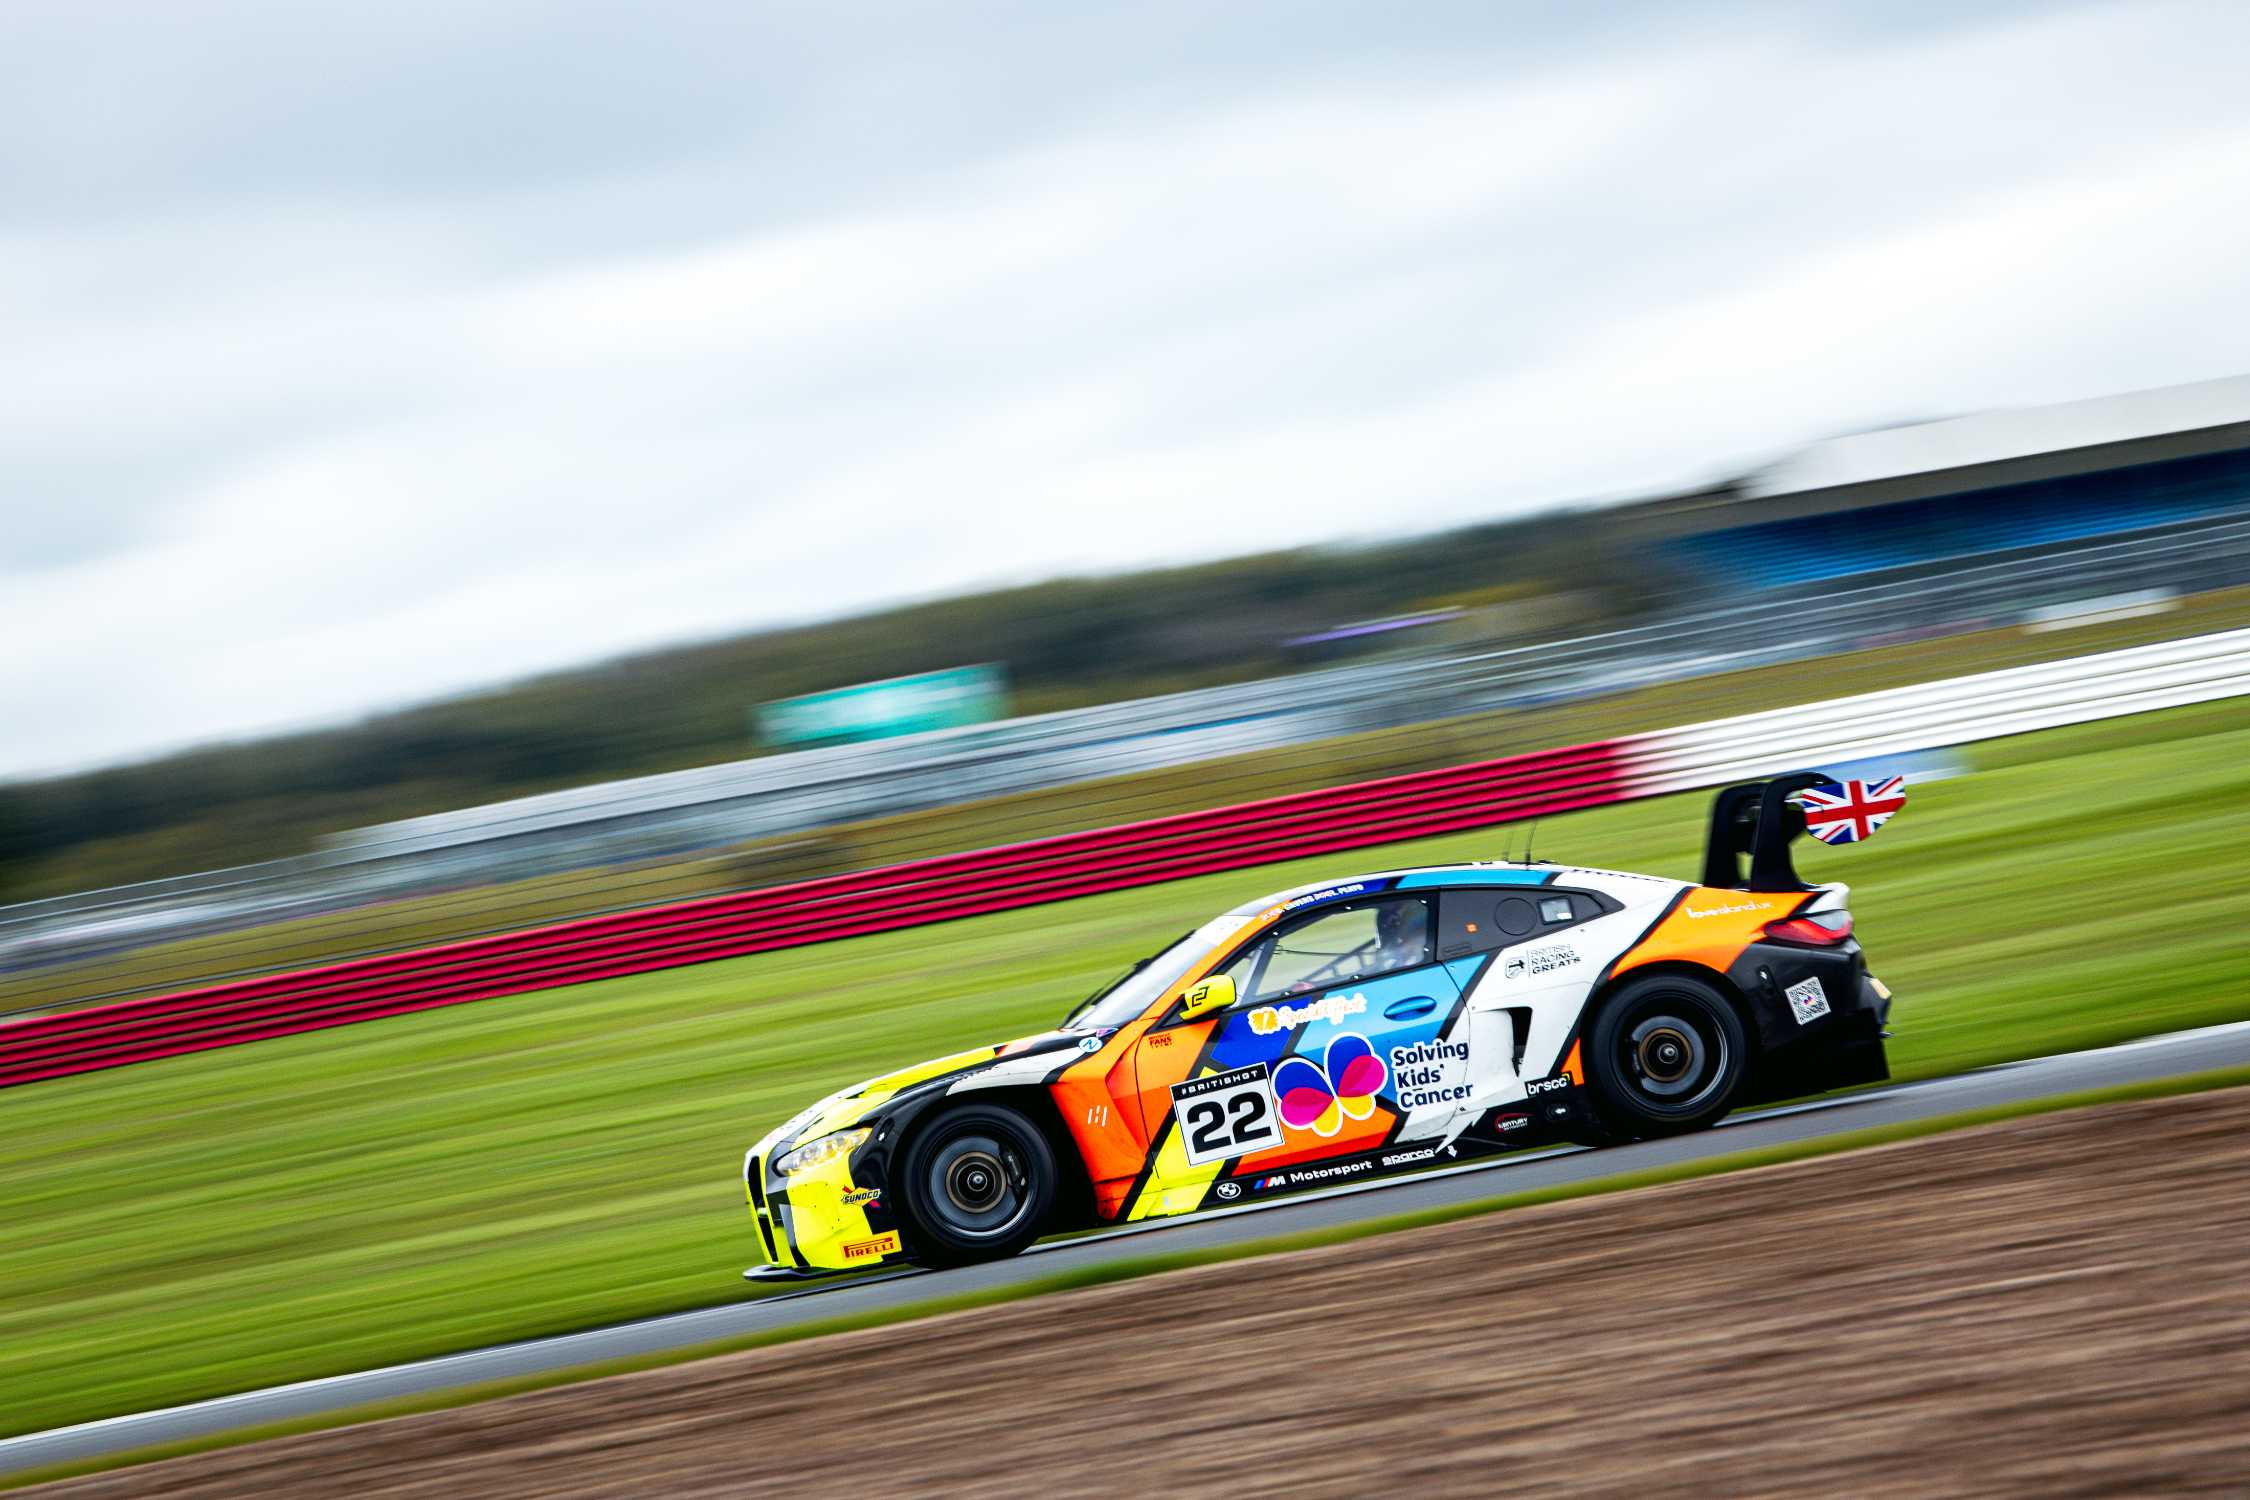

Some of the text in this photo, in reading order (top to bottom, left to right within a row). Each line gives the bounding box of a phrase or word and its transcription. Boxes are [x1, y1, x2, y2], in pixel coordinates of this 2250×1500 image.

[1532, 950, 1574, 966] RACING
[1393, 1042, 1469, 1066] Solving
[1181, 1070, 1258, 1095] #BRITISHGT
[1397, 1064, 1444, 1088] Kids'
[1527, 1077, 1567, 1095] brscc
[1401, 1085, 1473, 1108] Cancer
[1187, 1092, 1272, 1154] 22
[1382, 1149, 1435, 1166] sparco
[1290, 1160, 1373, 1183] Motorsport
[843, 1190, 879, 1203] SUNOCO
[844, 1237, 894, 1258] PIRELLI
